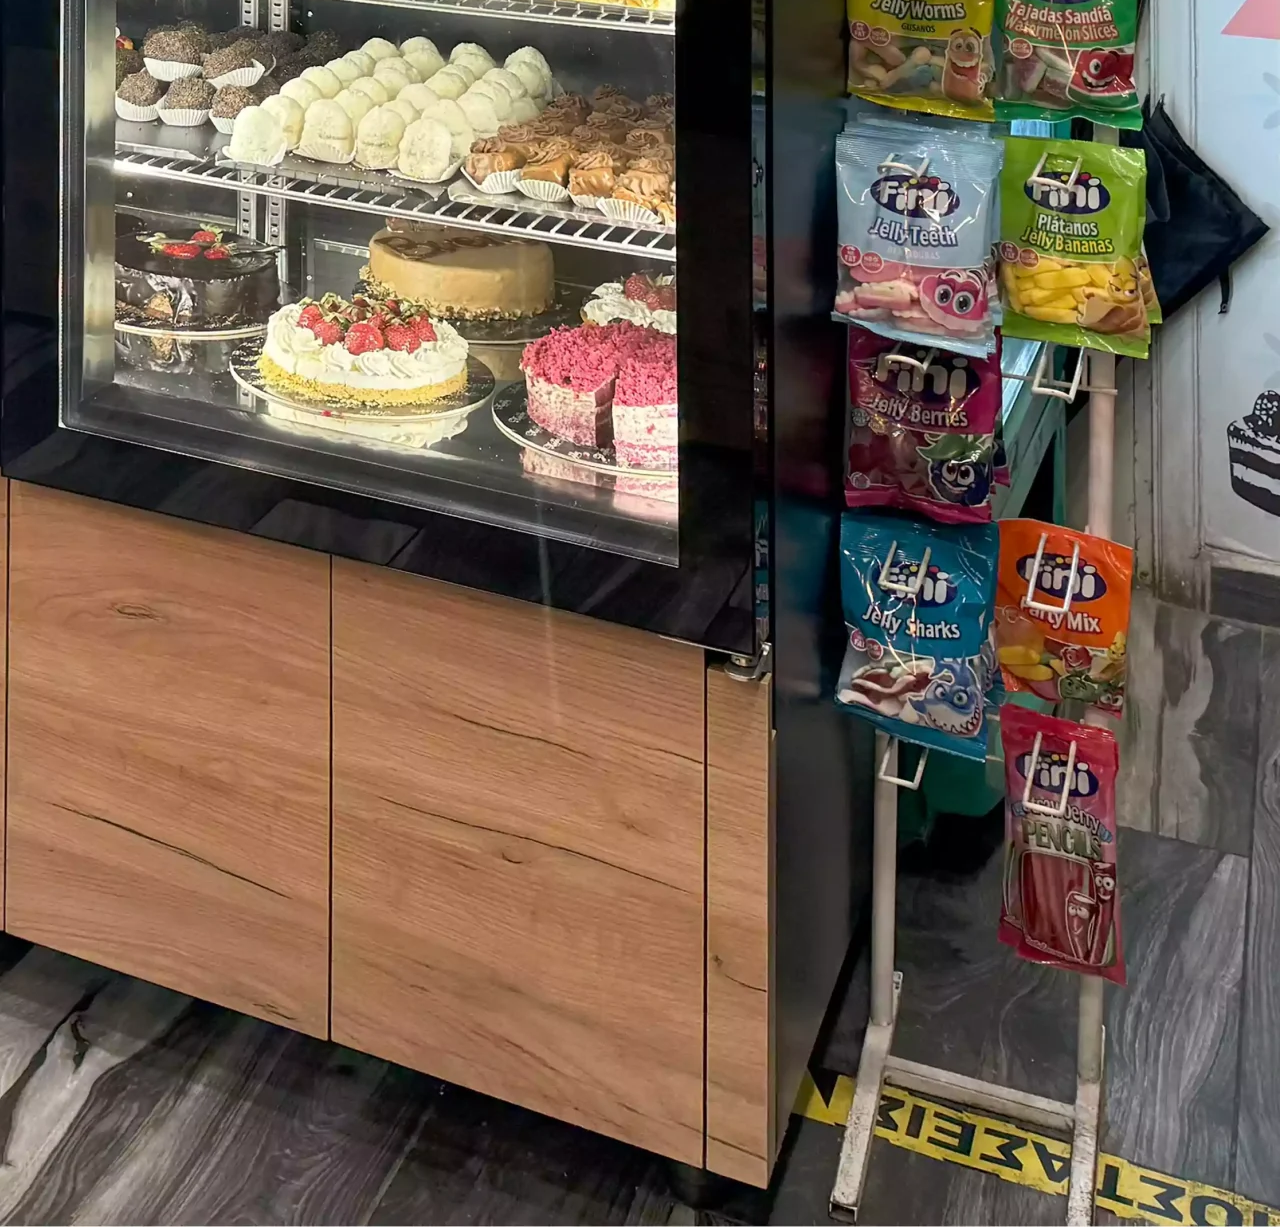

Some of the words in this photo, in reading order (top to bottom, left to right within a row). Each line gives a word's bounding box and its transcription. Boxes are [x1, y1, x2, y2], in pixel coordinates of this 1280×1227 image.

[910, 0, 965, 19] Worms
[1010, 0, 1063, 24] Tajadas
[1064, 5, 1113, 25] Sandía
[901, 22, 936, 33] GUSANOS
[1005, 13, 1080, 40] Watermelon
[1081, 24, 1118, 41] Slices
[879, 181, 950, 215] Fini
[1032, 178, 1100, 210] Fini
[869, 217, 909, 243] Jelly
[910, 225, 956, 245] Teeth
[1038, 214, 1098, 236] Plátanos
[1021, 227, 1054, 249] Jelly
[1055, 234, 1113, 254] Bananas
[876, 352, 969, 399] Fini
[872, 393, 910, 420] Jelly
[910, 404, 968, 427] Berries
[862, 605, 902, 634] Jelly
[905, 618, 961, 639] Sharks
[1066, 611, 1102, 633] Mix
